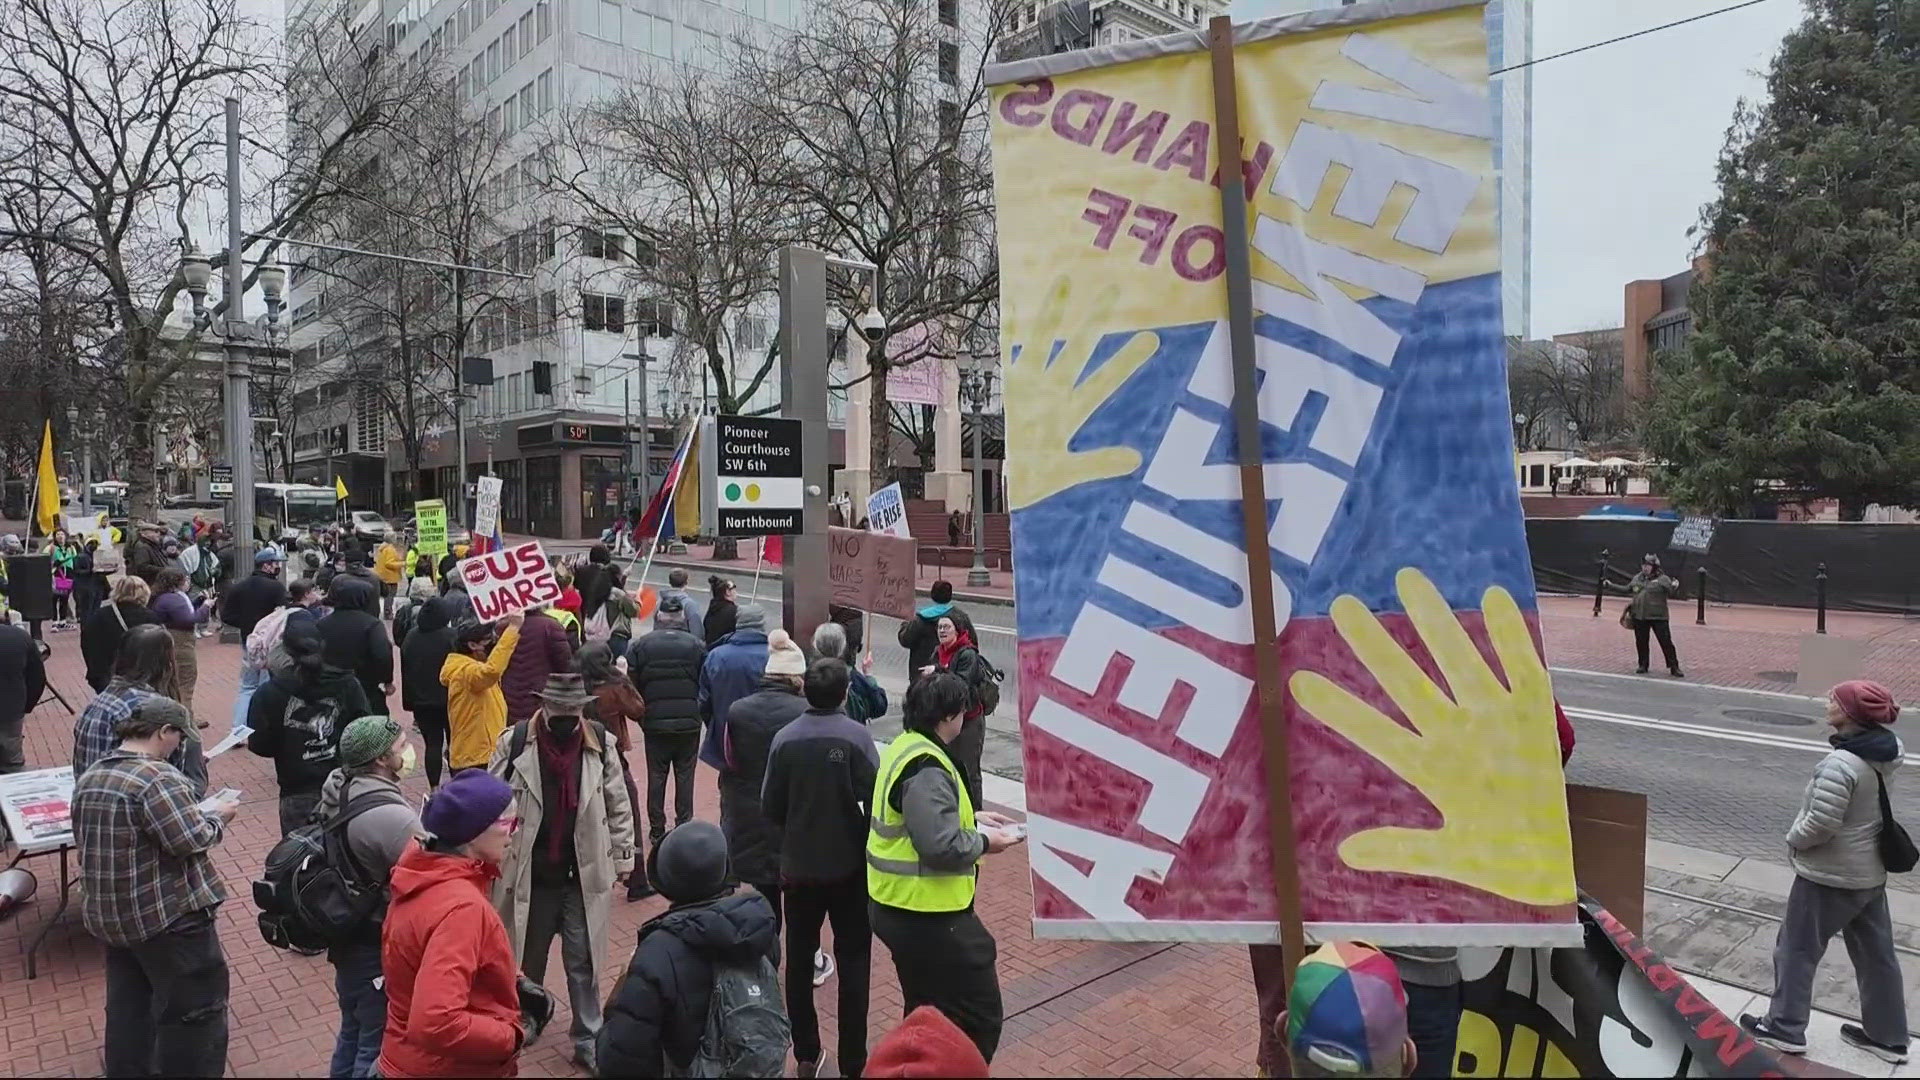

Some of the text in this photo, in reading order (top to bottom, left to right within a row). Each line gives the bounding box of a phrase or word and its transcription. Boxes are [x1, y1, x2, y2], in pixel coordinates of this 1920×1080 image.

[724, 424, 769, 439] Pioneer
[724, 441, 791, 456] Courthouse
[725, 459, 767, 471] SW 6th
[868, 489, 899, 511] TOGETHER
[725, 515, 793, 529] Northbound
[870, 503, 902, 530] WE RISE
[831, 533, 860, 557] NO
[485, 543, 545, 580] US
[830, 565, 864, 584] WARS
[473, 573, 558, 620] WARS
